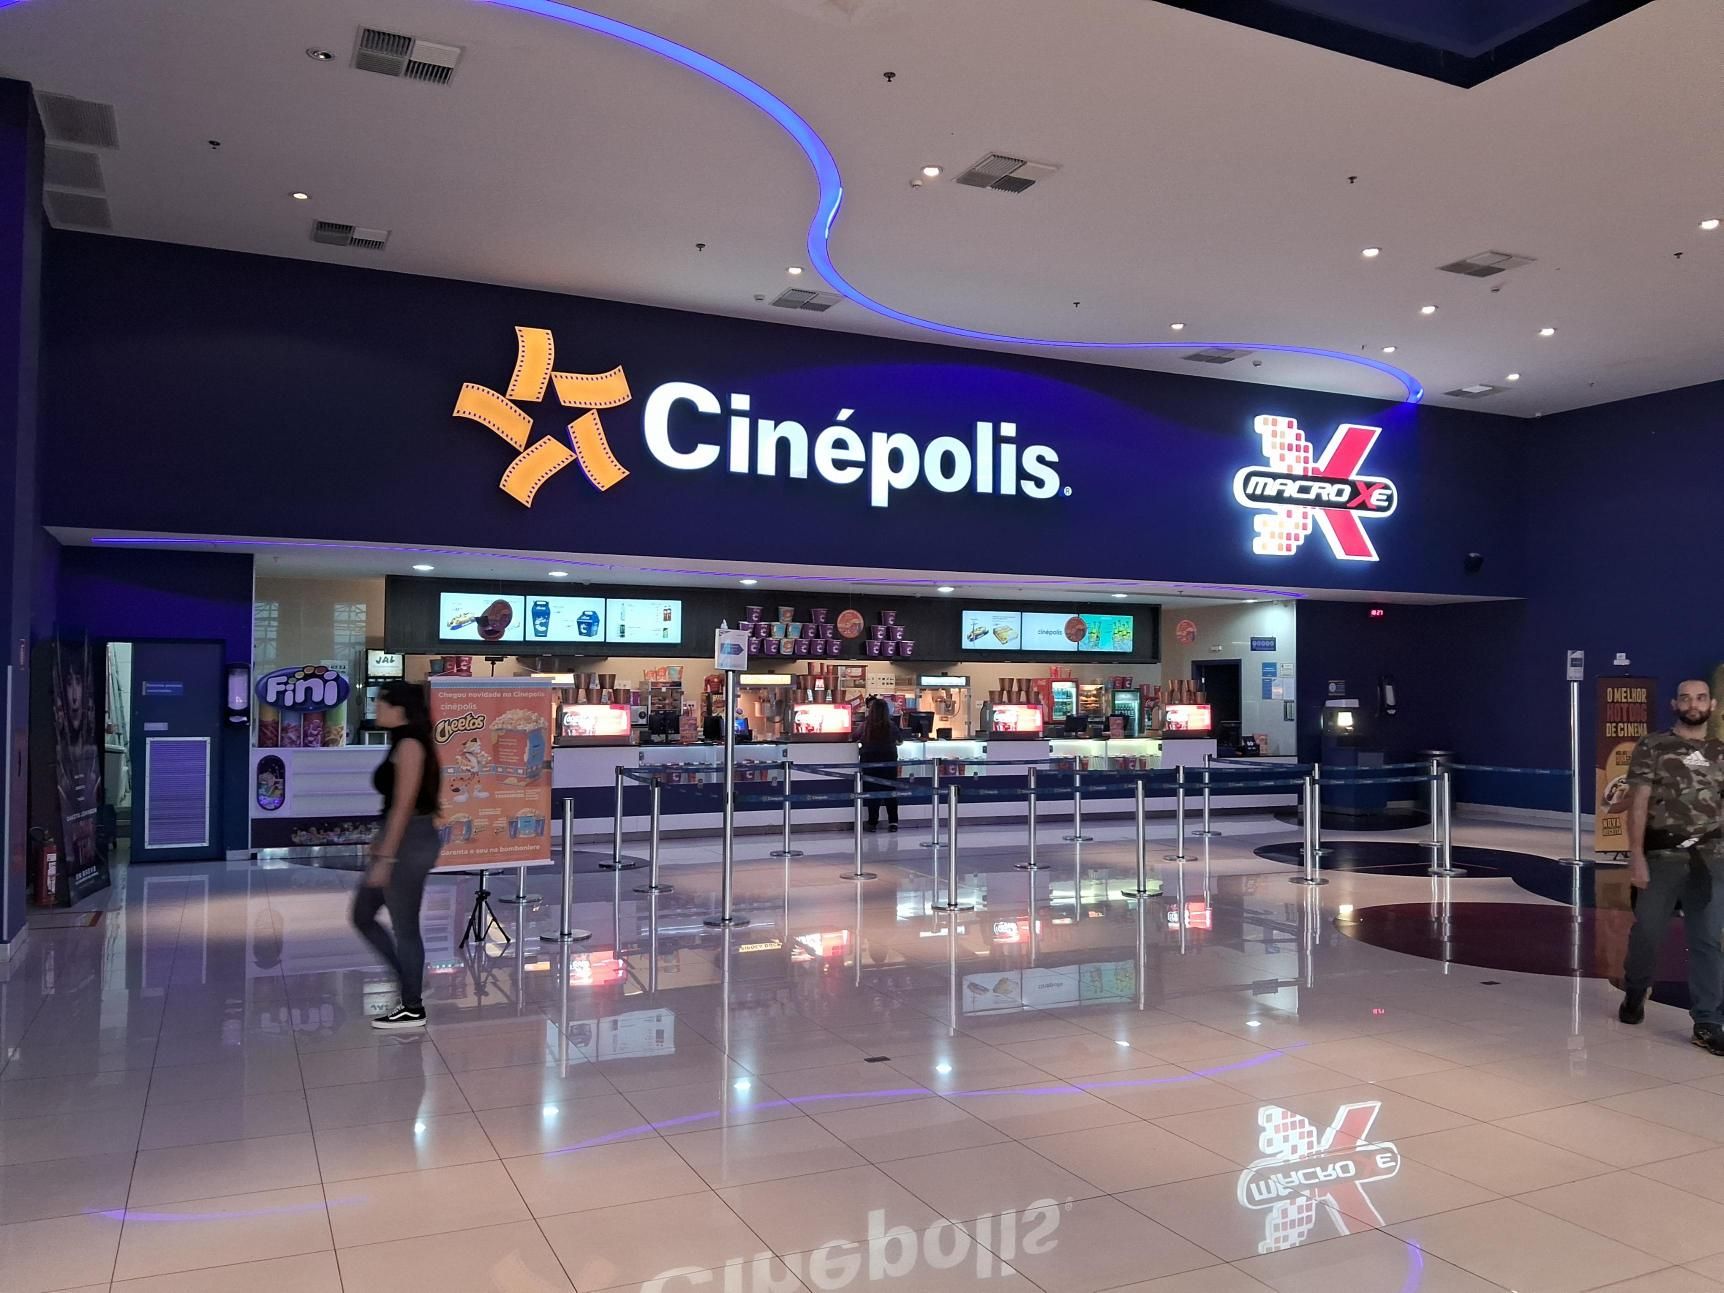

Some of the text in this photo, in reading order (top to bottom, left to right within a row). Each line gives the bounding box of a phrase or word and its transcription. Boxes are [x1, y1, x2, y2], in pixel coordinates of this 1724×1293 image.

[644, 382, 1061, 507] Cinépolis
[266, 671, 338, 706] Fini
[438, 691, 466, 699] Chegou
[1614, 687, 1647, 703] MELHOR
[435, 713, 486, 743] Cheetos
[1606, 722, 1648, 737] DE CINEMA
